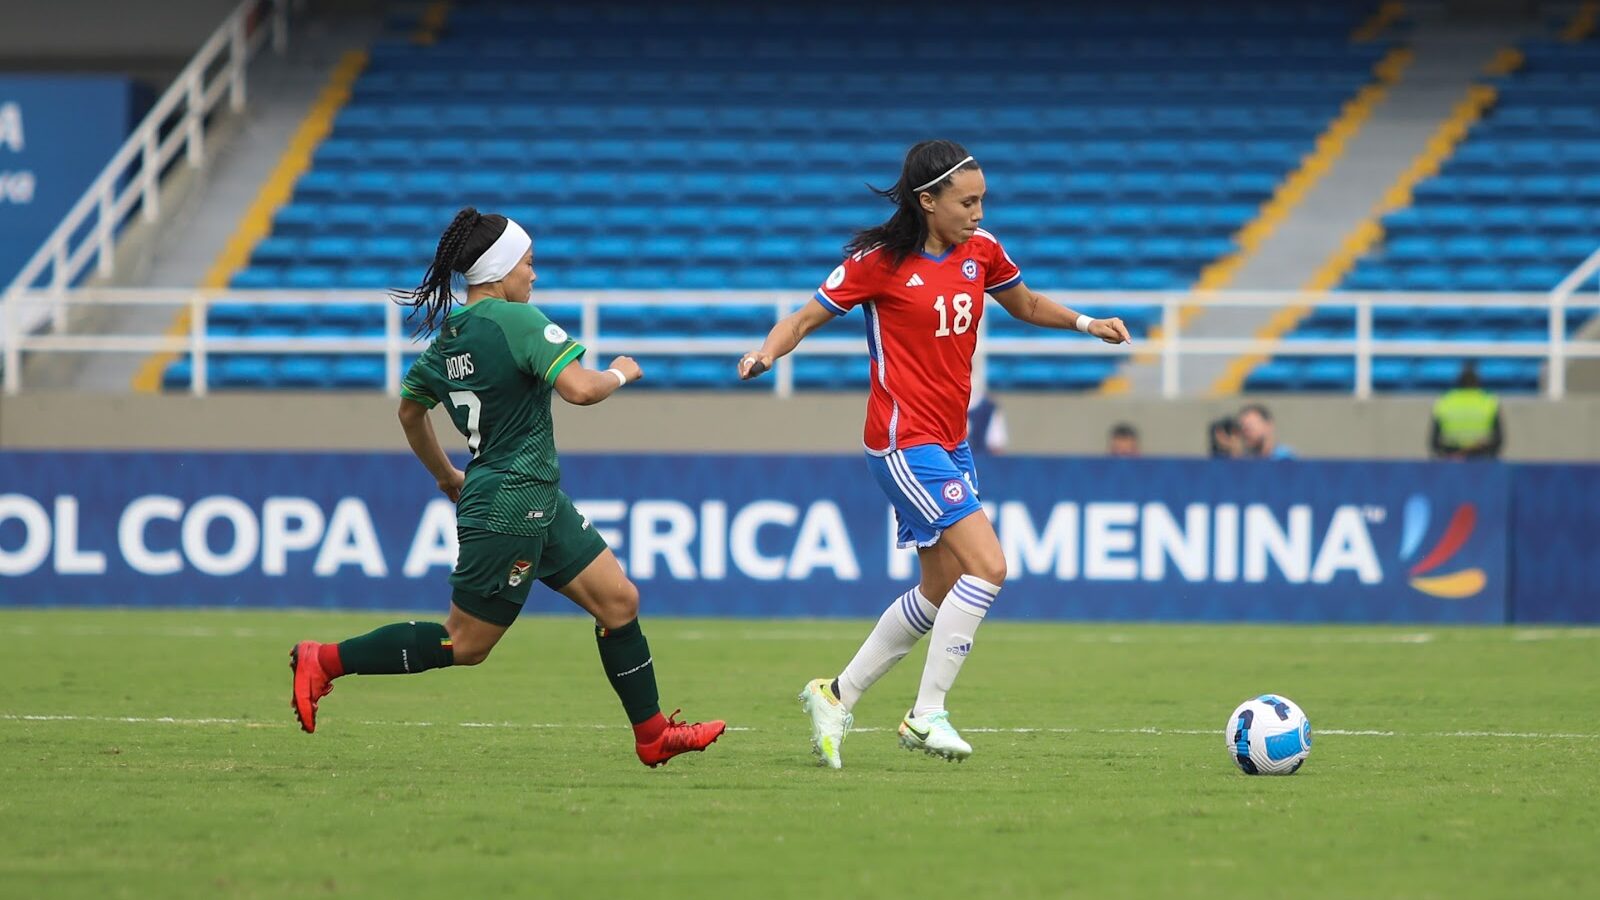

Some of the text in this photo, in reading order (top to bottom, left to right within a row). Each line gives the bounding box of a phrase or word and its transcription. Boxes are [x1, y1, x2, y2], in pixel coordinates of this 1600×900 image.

[934, 293, 973, 338] 18
[446, 353, 474, 380] ROJAS
[449, 391, 481, 459] 7
[118, 495, 388, 576] COPA
[403, 497, 860, 580] AERICA
